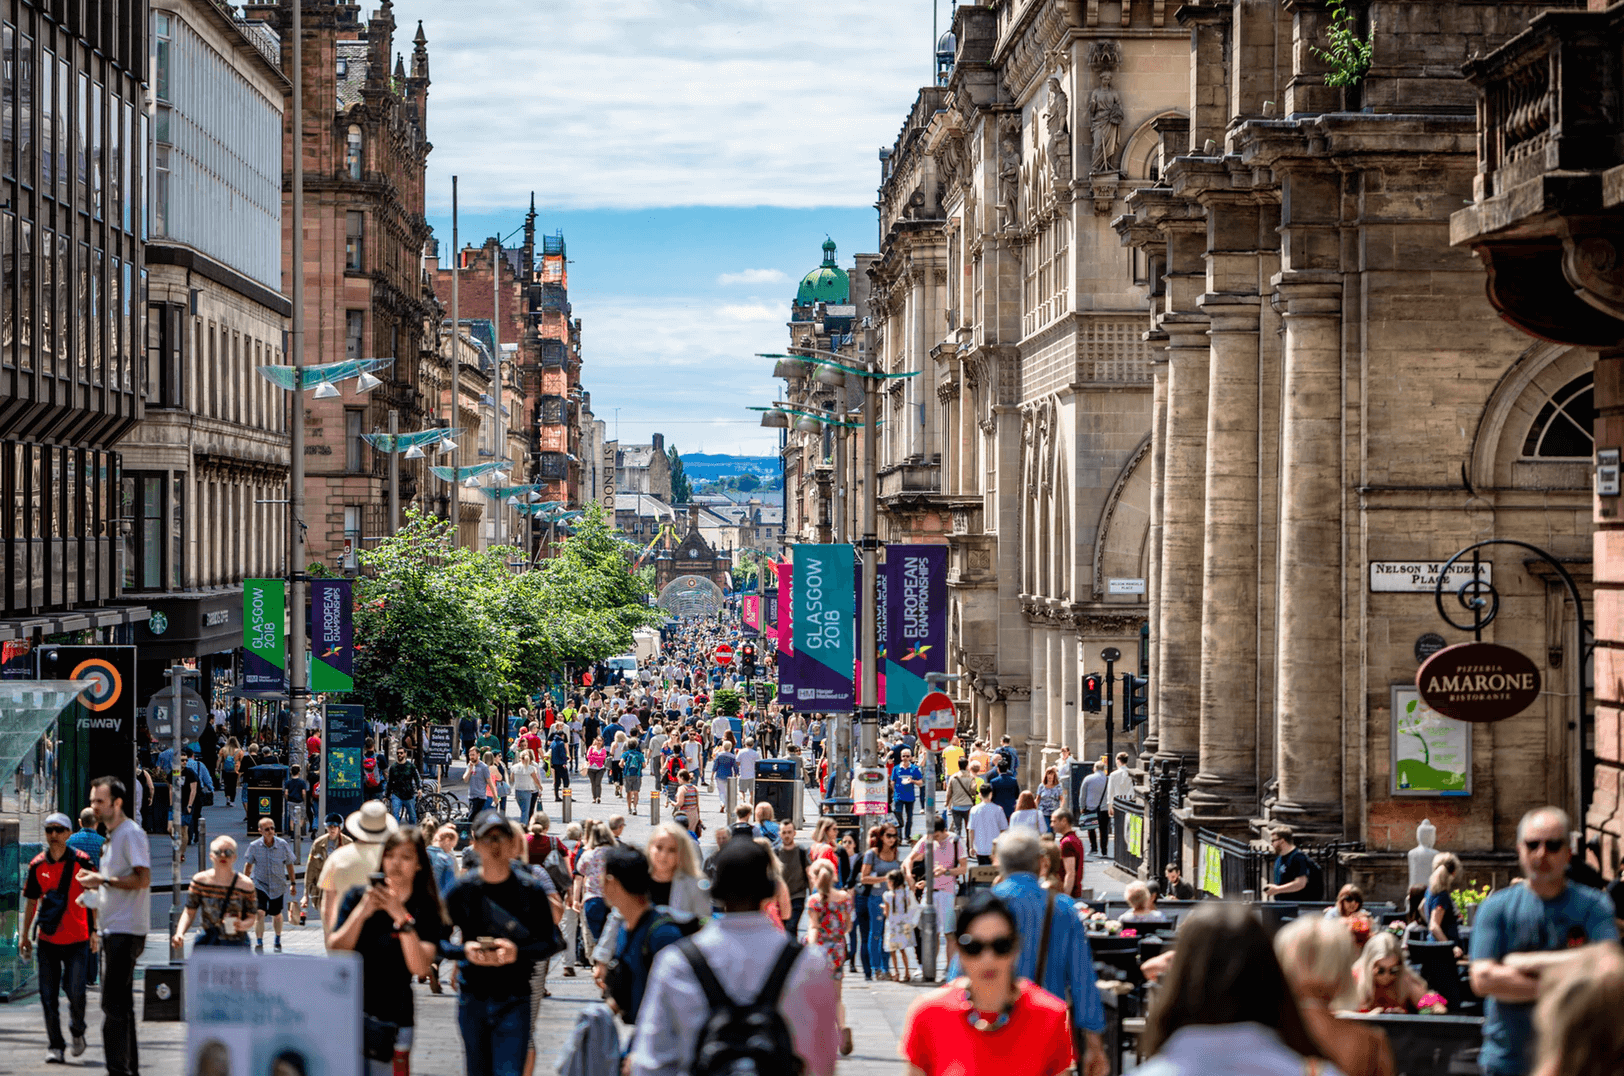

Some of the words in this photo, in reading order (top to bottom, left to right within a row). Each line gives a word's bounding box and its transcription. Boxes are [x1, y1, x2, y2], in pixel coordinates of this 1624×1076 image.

[604, 449, 614, 463] ST
[1376, 564, 1422, 574] NELSON
[1411, 575, 1451, 584] PLACE
[806, 557, 823, 649] GLASGOW
[904, 557, 918, 638] EUROPEAN
[918, 557, 929, 638] CHAMPIONSHIPS
[252, 588, 264, 649] GLASGOW
[323, 587, 334, 642] EUROPEAN
[333, 587, 341, 642] CHAMPIONSHIPS
[264, 622, 276, 649] 2018
[824, 610, 840, 649] 2018
[1456, 665, 1503, 673] PIZZERIA
[799, 690, 814, 698] HM
[1427, 673, 1534, 693] AMARONE
[1449, 693, 1512, 702] RISTORANTE
